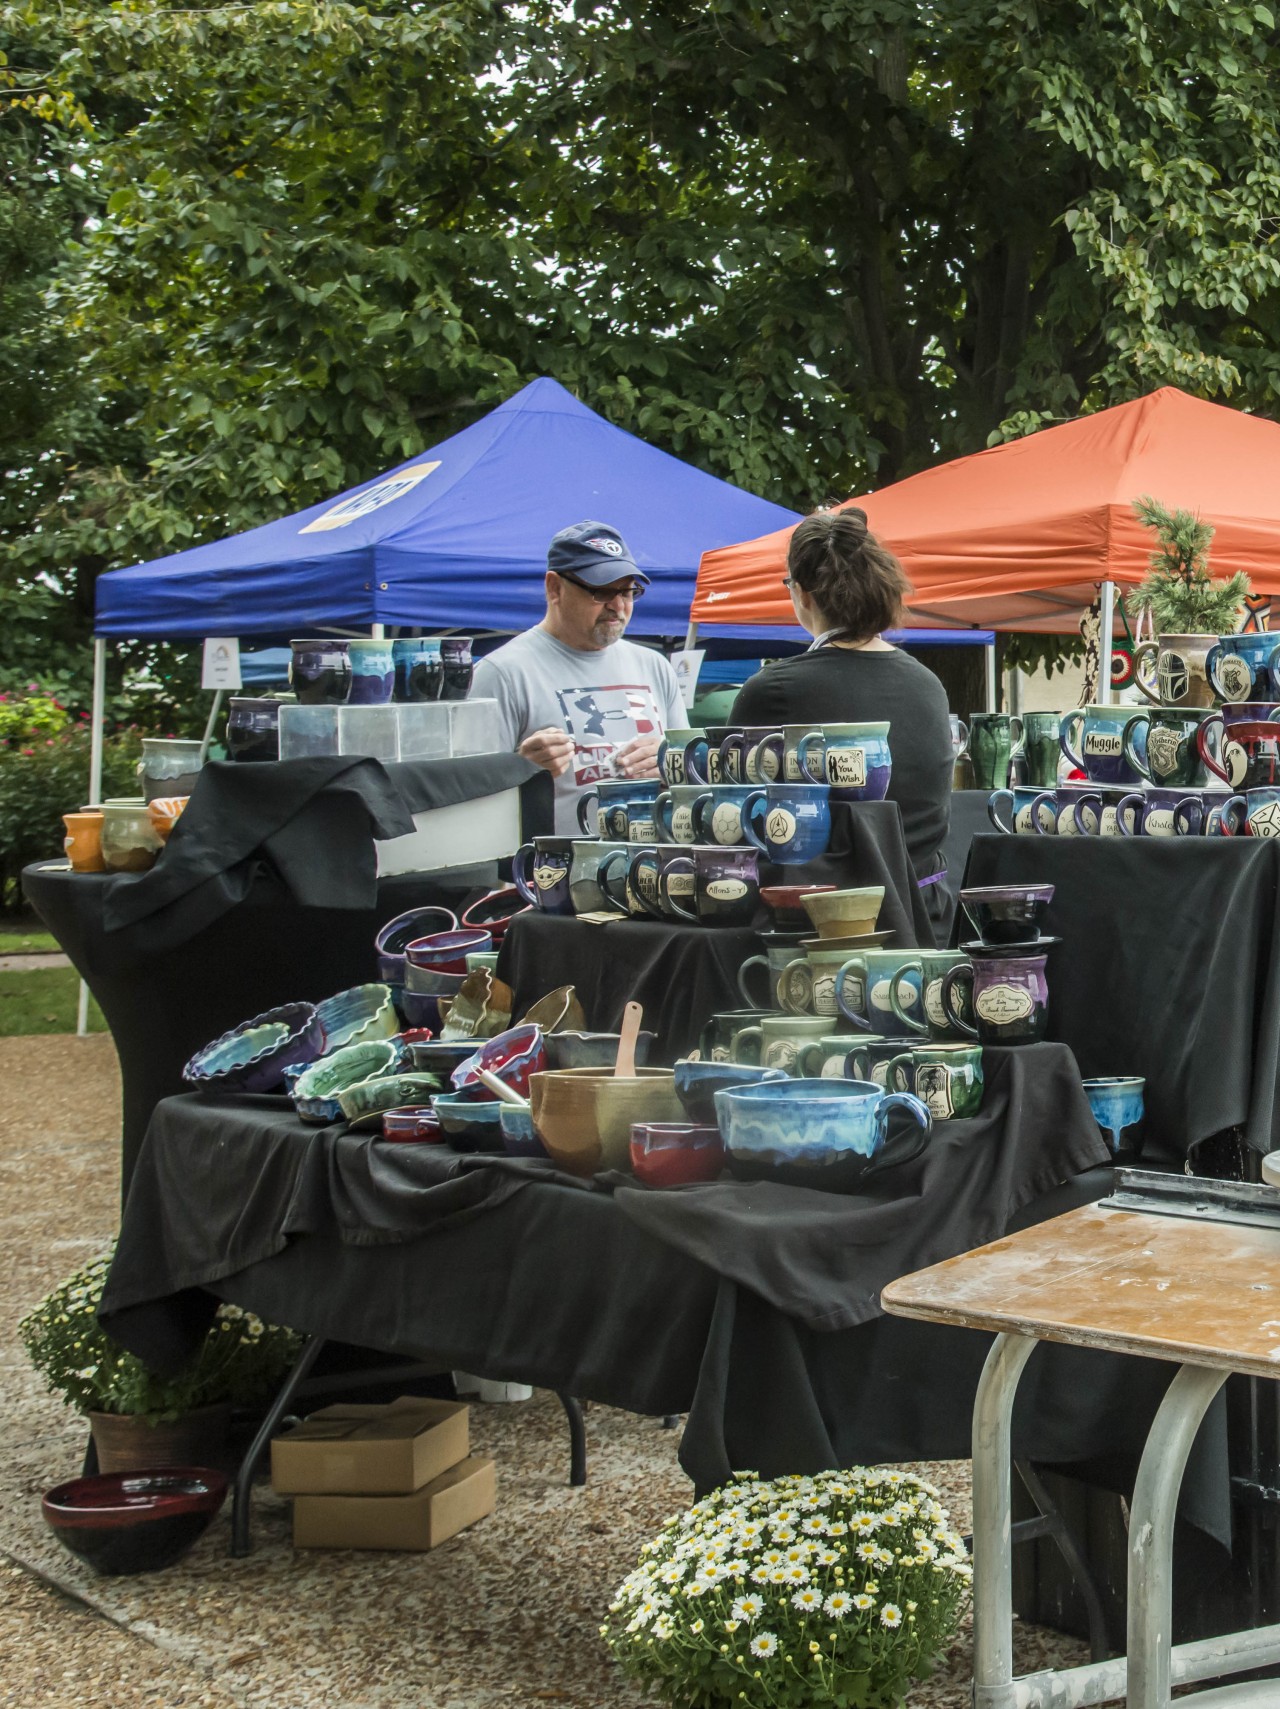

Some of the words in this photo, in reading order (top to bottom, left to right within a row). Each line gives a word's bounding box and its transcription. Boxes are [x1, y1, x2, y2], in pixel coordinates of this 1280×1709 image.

[1086, 735, 1120, 752] Muggle
[790, 757, 818, 765] INON
[838, 765, 853, 773] You
[838, 774, 860, 783] Wish
